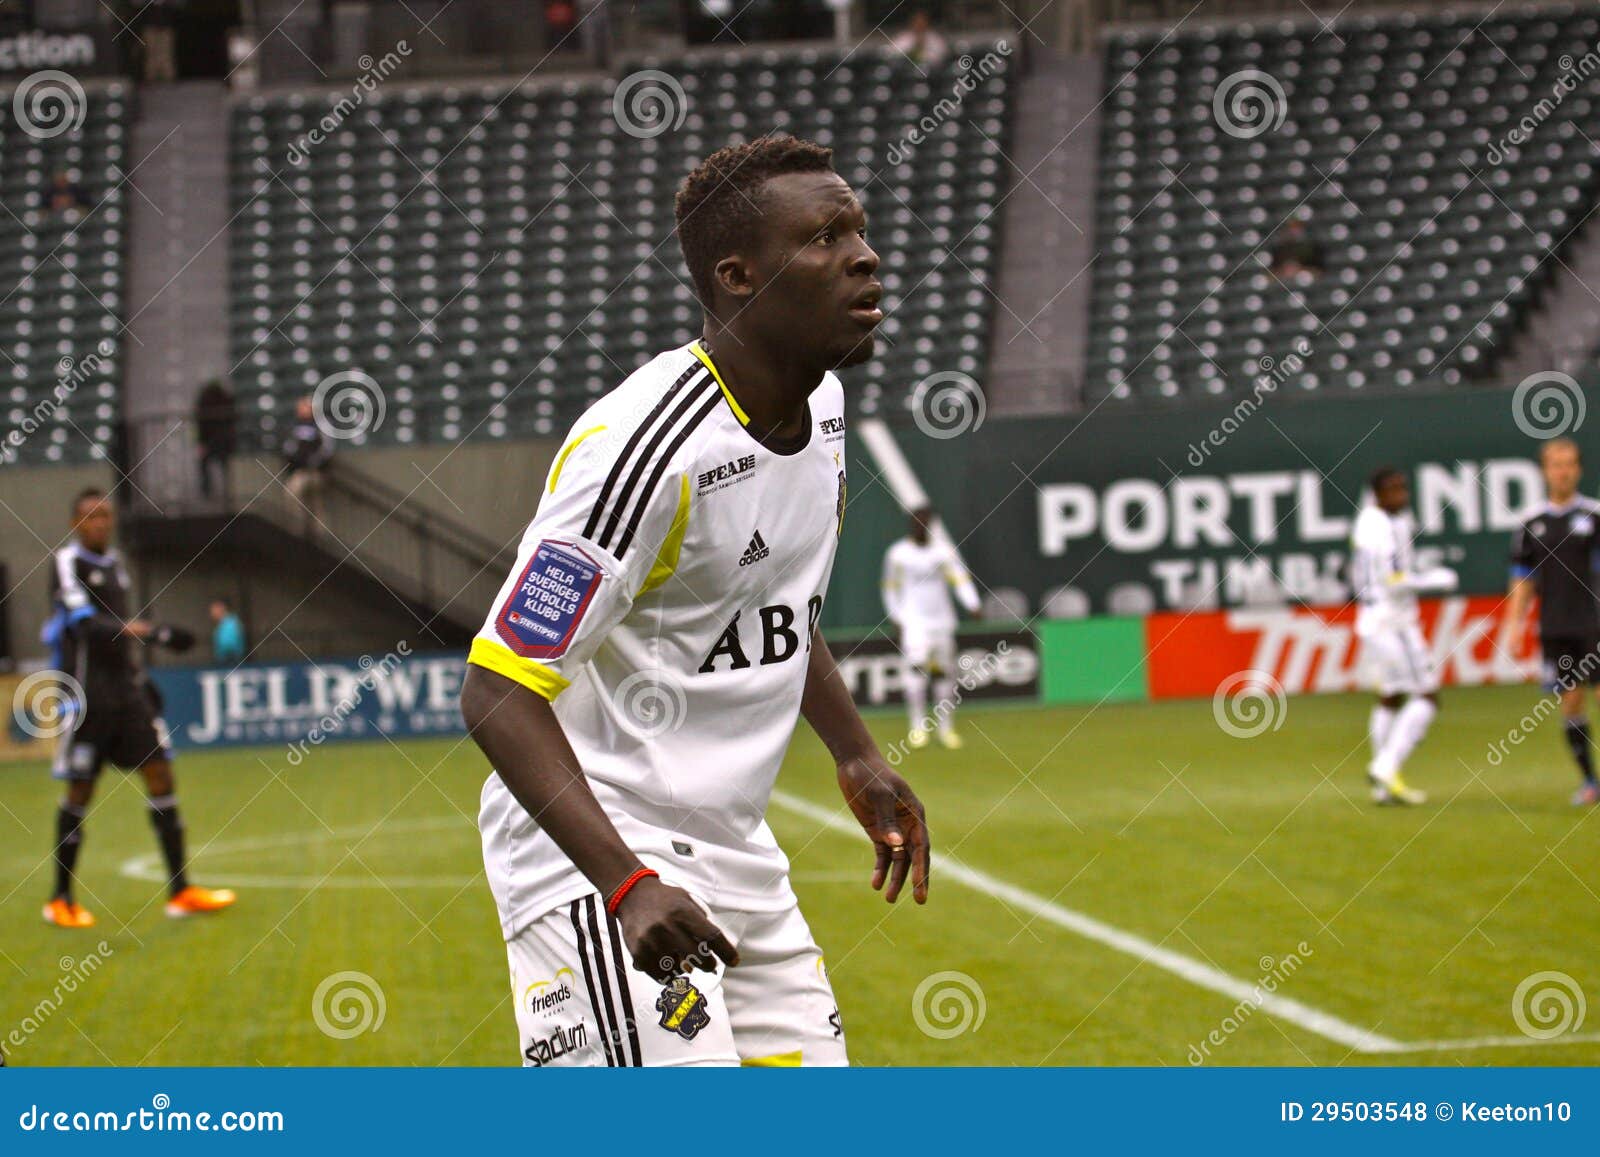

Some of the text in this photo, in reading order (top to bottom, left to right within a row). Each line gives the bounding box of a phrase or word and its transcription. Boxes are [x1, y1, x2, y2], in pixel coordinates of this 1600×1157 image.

[706, 456, 749, 486] PEAB
[1038, 458, 1544, 555] PORTLND
[739, 547, 770, 567] adidas
[528, 571, 580, 602] SVERIGES
[545, 565, 575, 585] HELA
[521, 582, 577, 615] FOTBOLLS
[524, 597, 561, 622] KLUBB
[531, 983, 571, 1014] friends
[525, 1021, 588, 1067] stadium
